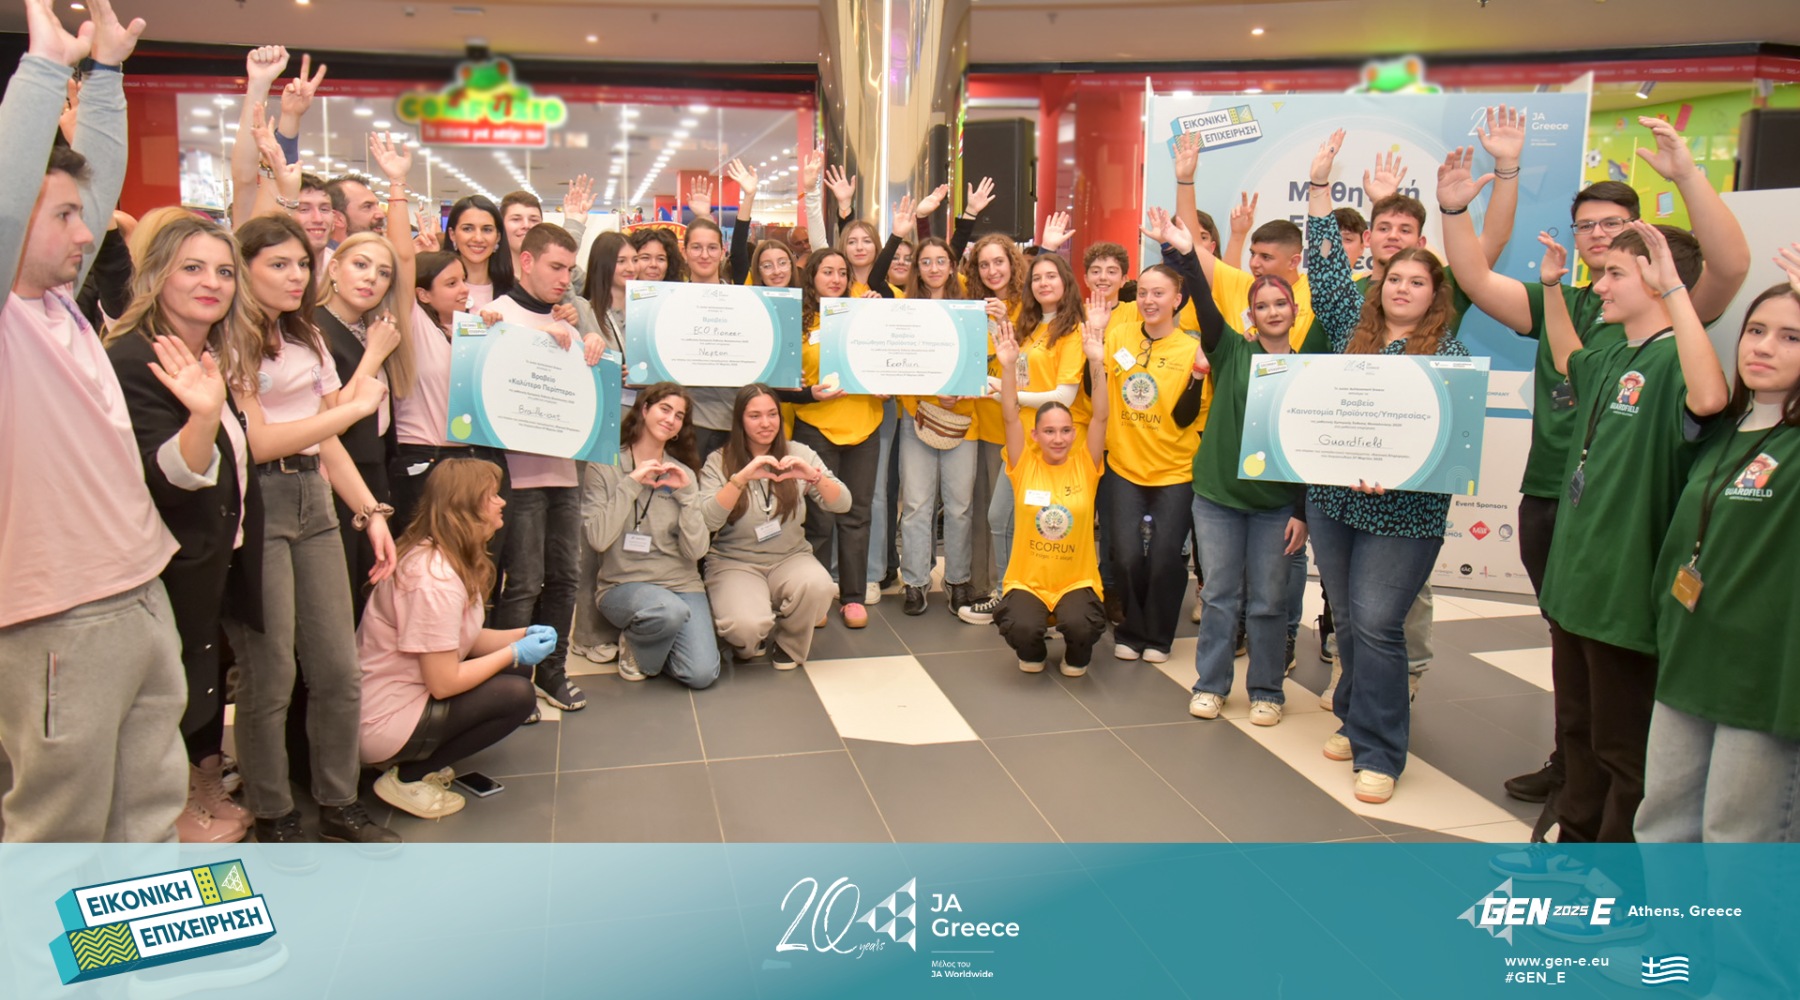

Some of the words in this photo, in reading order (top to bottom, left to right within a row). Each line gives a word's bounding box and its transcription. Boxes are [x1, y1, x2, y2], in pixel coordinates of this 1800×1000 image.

[1183, 114, 1228, 130] ΕΙΚΟΝΙΚΗ
[1532, 112, 1545, 121] JA
[1531, 122, 1569, 130] Greece
[1204, 125, 1258, 143] ΕΠΙΧΕΙΡΗΣΗ
[1341, 398, 1375, 408] Βραβείο
[1121, 410, 1162, 424] ECORUN
[1724, 487, 1773, 498] GUARDFIELD
[1476, 501, 1508, 510] Sponsors
[1029, 539, 1076, 554] ECORUN
